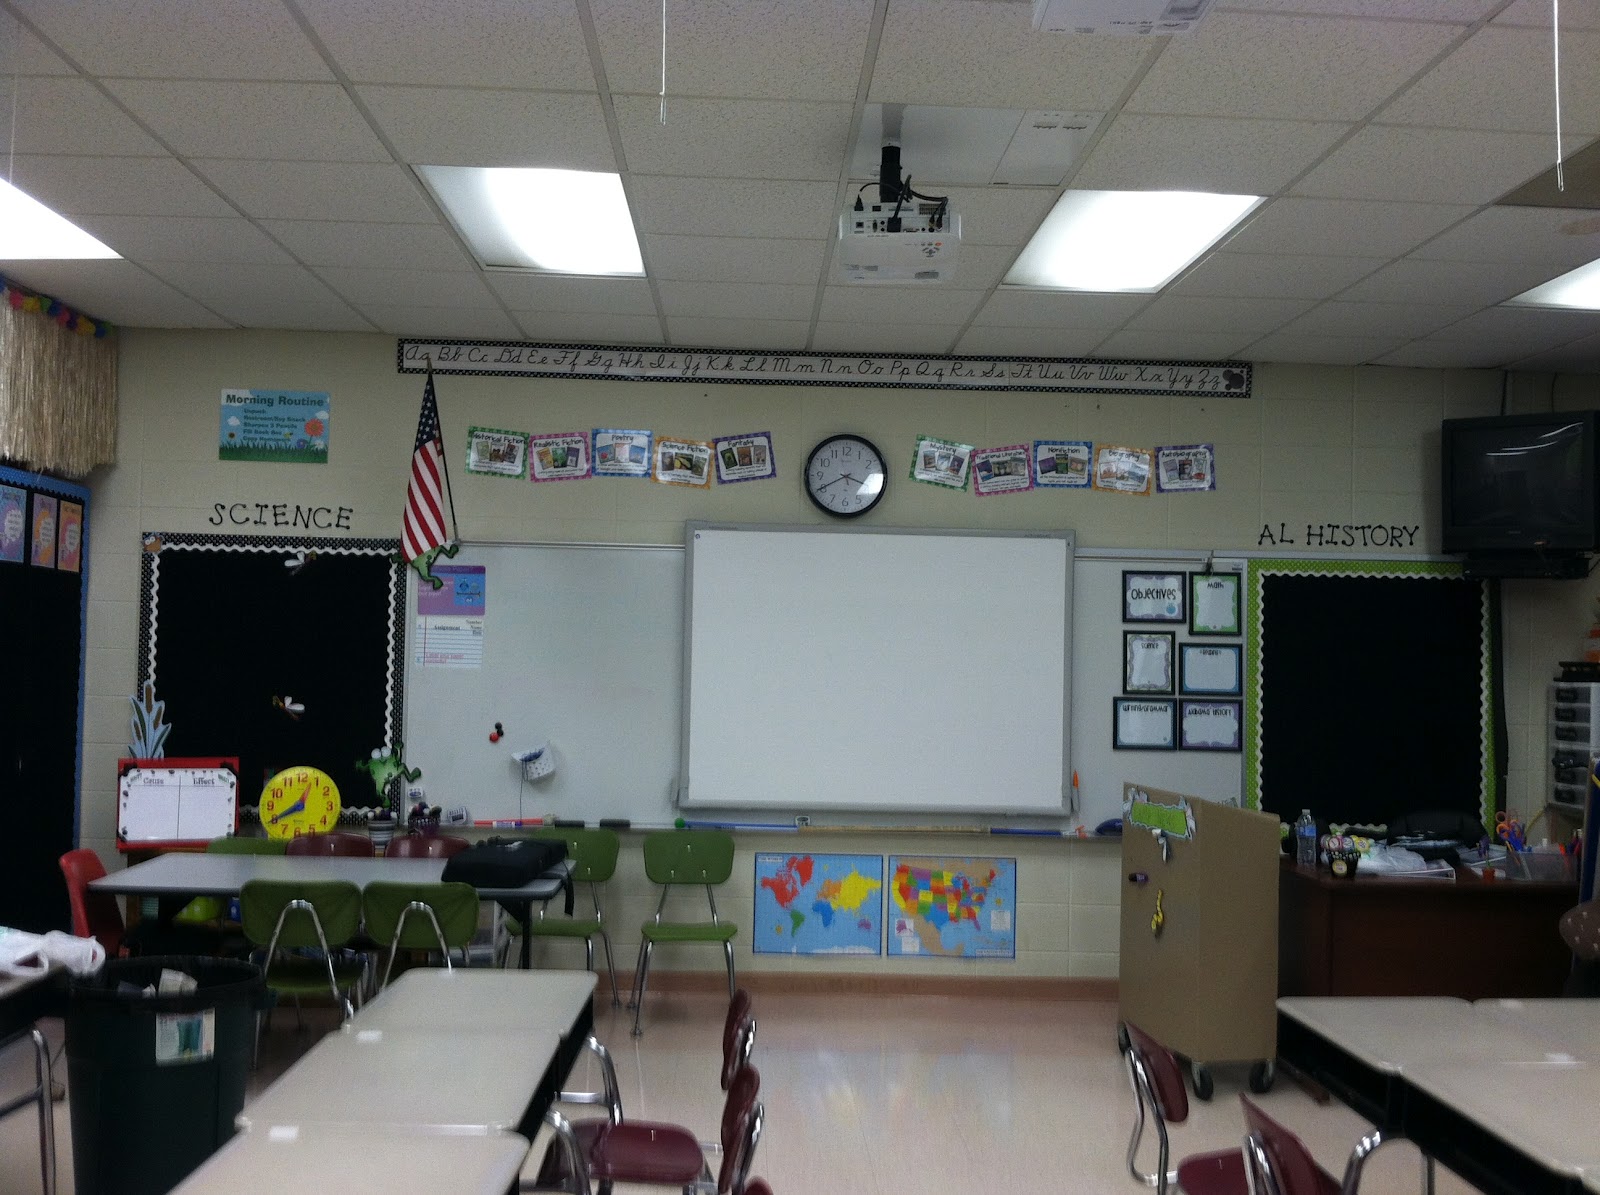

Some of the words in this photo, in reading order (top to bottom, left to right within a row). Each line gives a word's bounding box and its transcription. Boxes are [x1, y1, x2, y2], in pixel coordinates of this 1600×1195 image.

[225, 394, 274, 407] Morning
[278, 395, 324, 407] Routine
[503, 437, 526, 445] Fiction
[562, 438, 585, 446] Fiction
[662, 441, 686, 452] Science
[831, 449, 838, 459] 11
[842, 446, 852, 457] 12
[929, 442, 957, 456] Mystery
[820, 458, 831, 468] 10
[865, 459, 872, 470] 2
[816, 471, 824, 481] 9
[820, 483, 828, 494] 8
[829, 494, 836, 504] 7
[841, 497, 849, 507] 6
[855, 494, 862, 505] 5
[208, 502, 354, 530] SCIENCE
[1257, 522, 1294, 546] AL
[1306, 523, 1420, 548] HISTORY
[283, 776, 293, 787] 11
[295, 772, 308, 783] 12
[314, 776, 319, 787] 1
[271, 787, 283, 799] 10
[322, 786, 330, 796] 2
[266, 800, 274, 811] 9
[326, 800, 334, 811] 3
[271, 814, 278, 825] 8
[320, 814, 327, 825] 4
[281, 823, 288, 834] 7
[308, 824, 316, 834] 5
